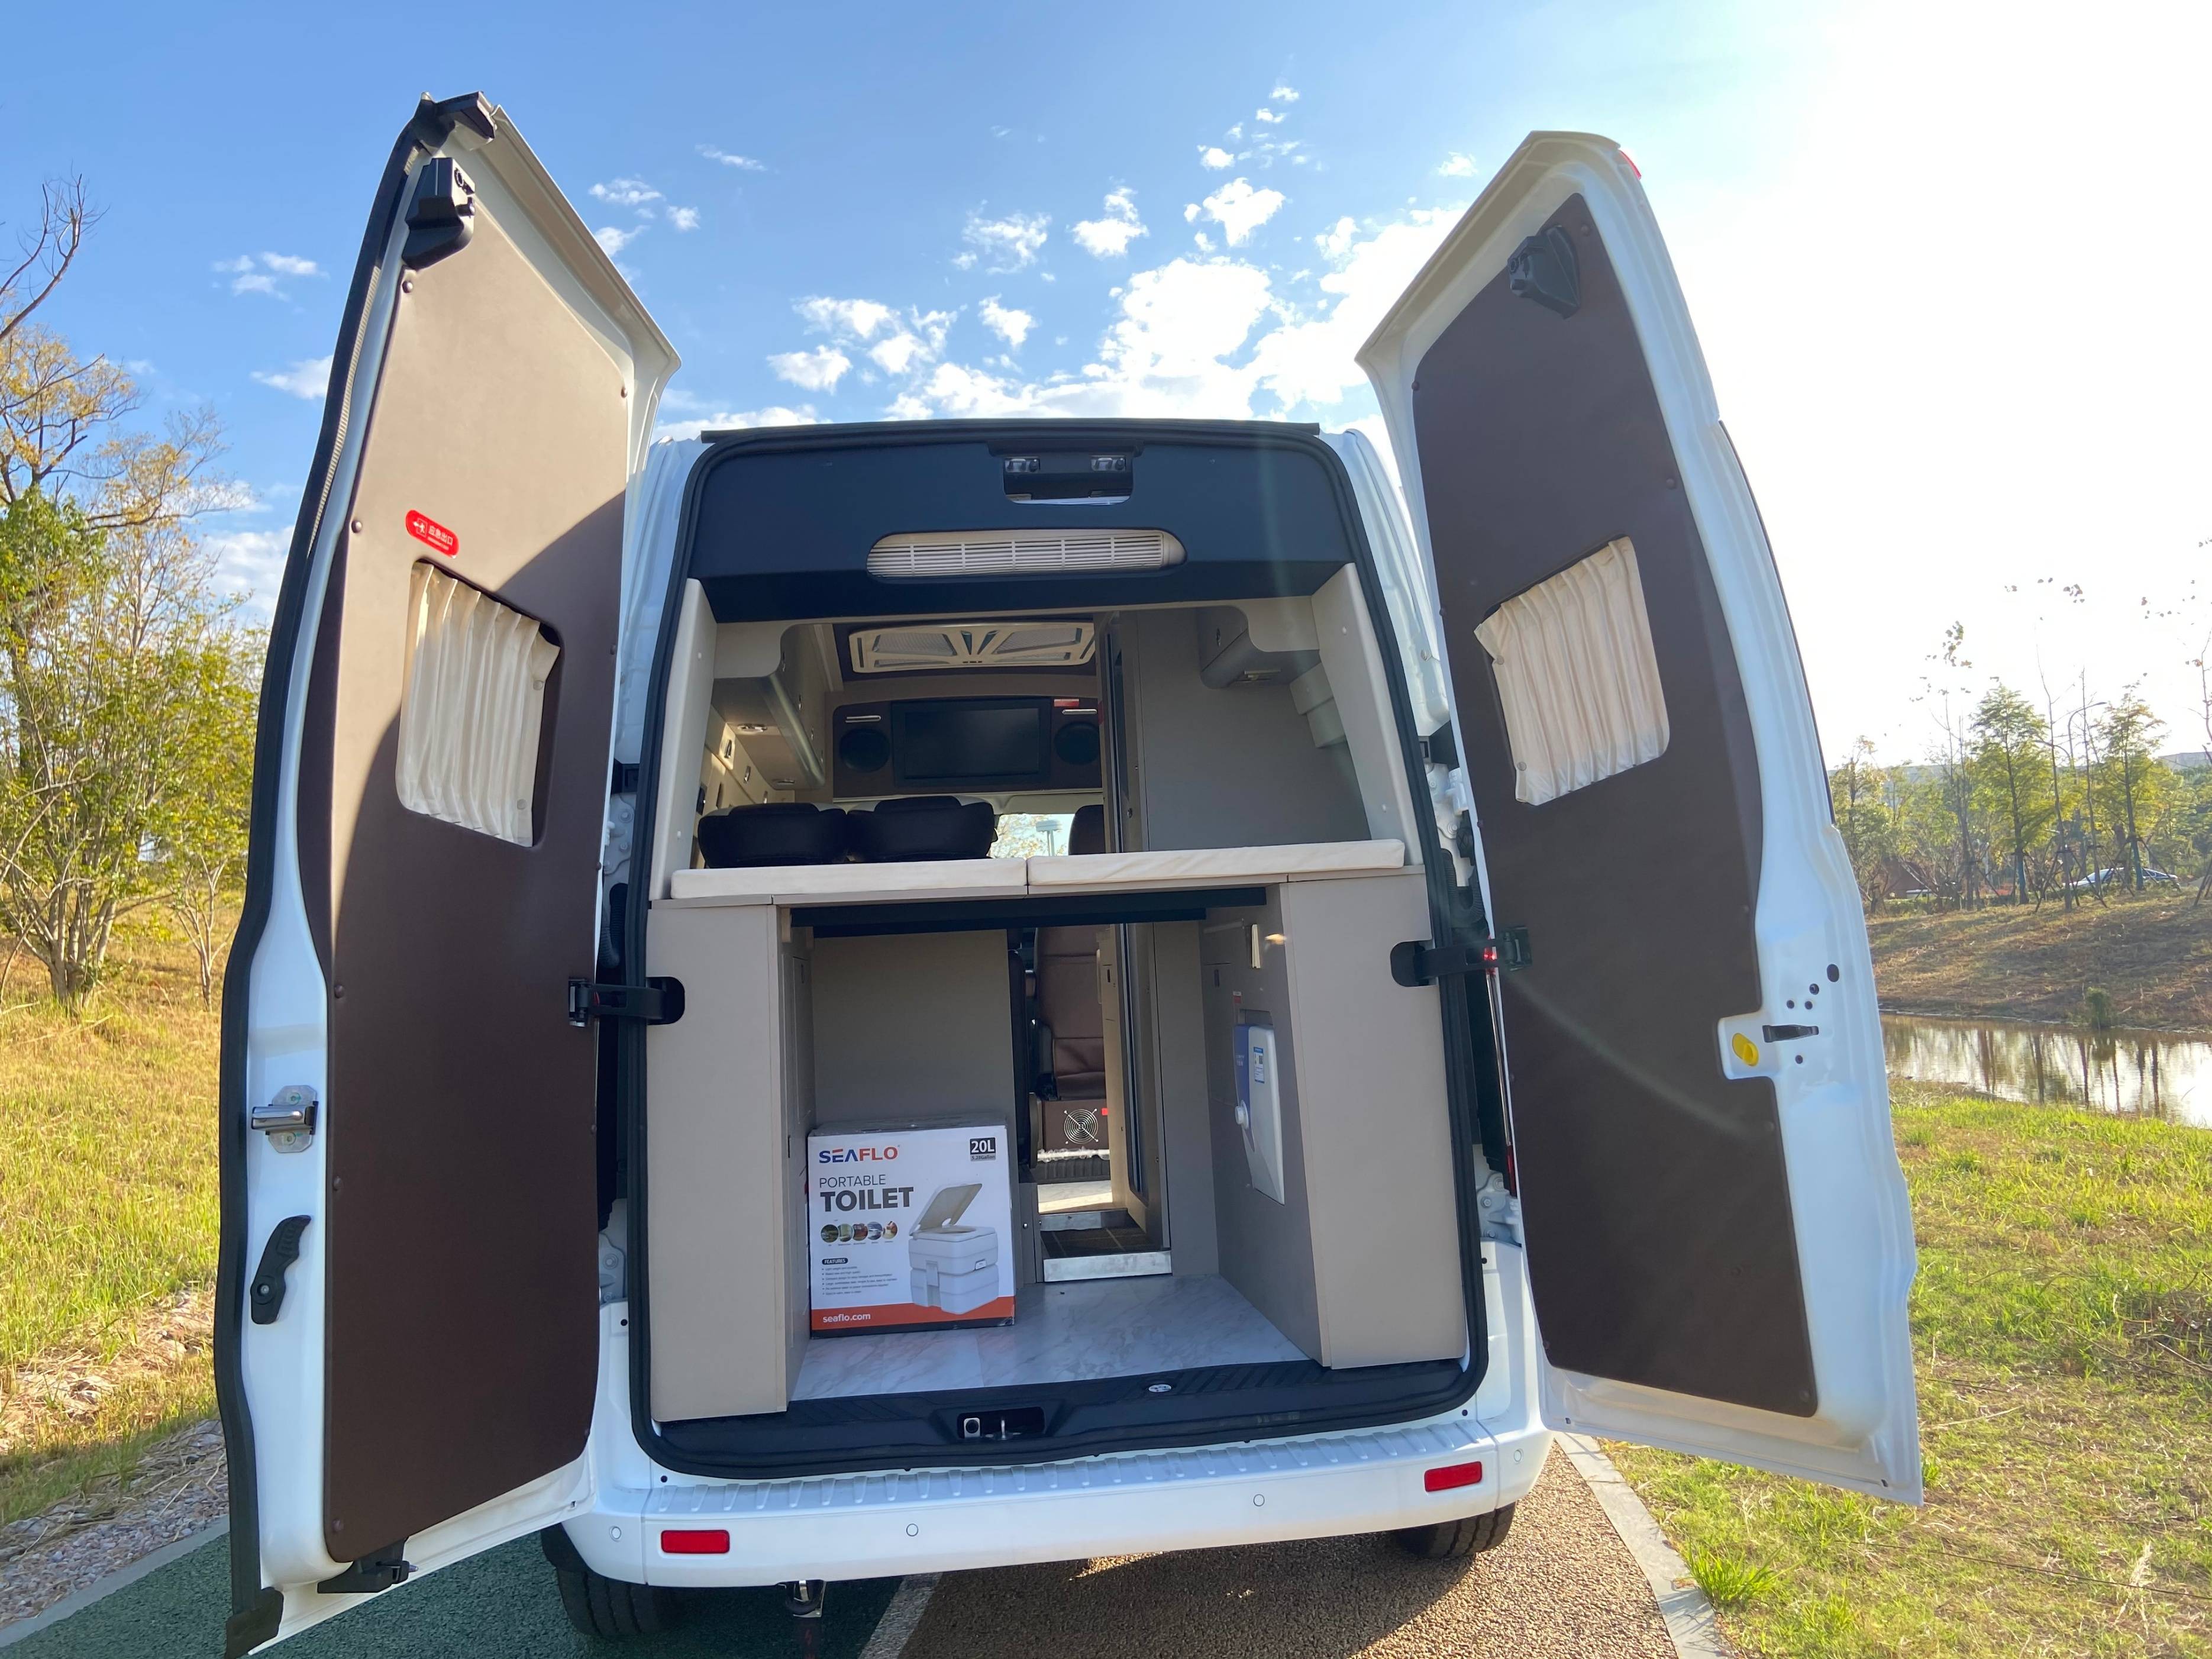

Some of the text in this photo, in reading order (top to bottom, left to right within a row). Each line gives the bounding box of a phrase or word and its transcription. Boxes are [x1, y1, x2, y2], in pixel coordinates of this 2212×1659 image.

[971, 1140, 994, 1153] 20L
[819, 1147, 897, 1163] SEAFLO
[819, 1174, 886, 1188] PORTABLE
[820, 1186, 914, 1212] TOILET
[822, 1313, 871, 1323] seaflo.com
